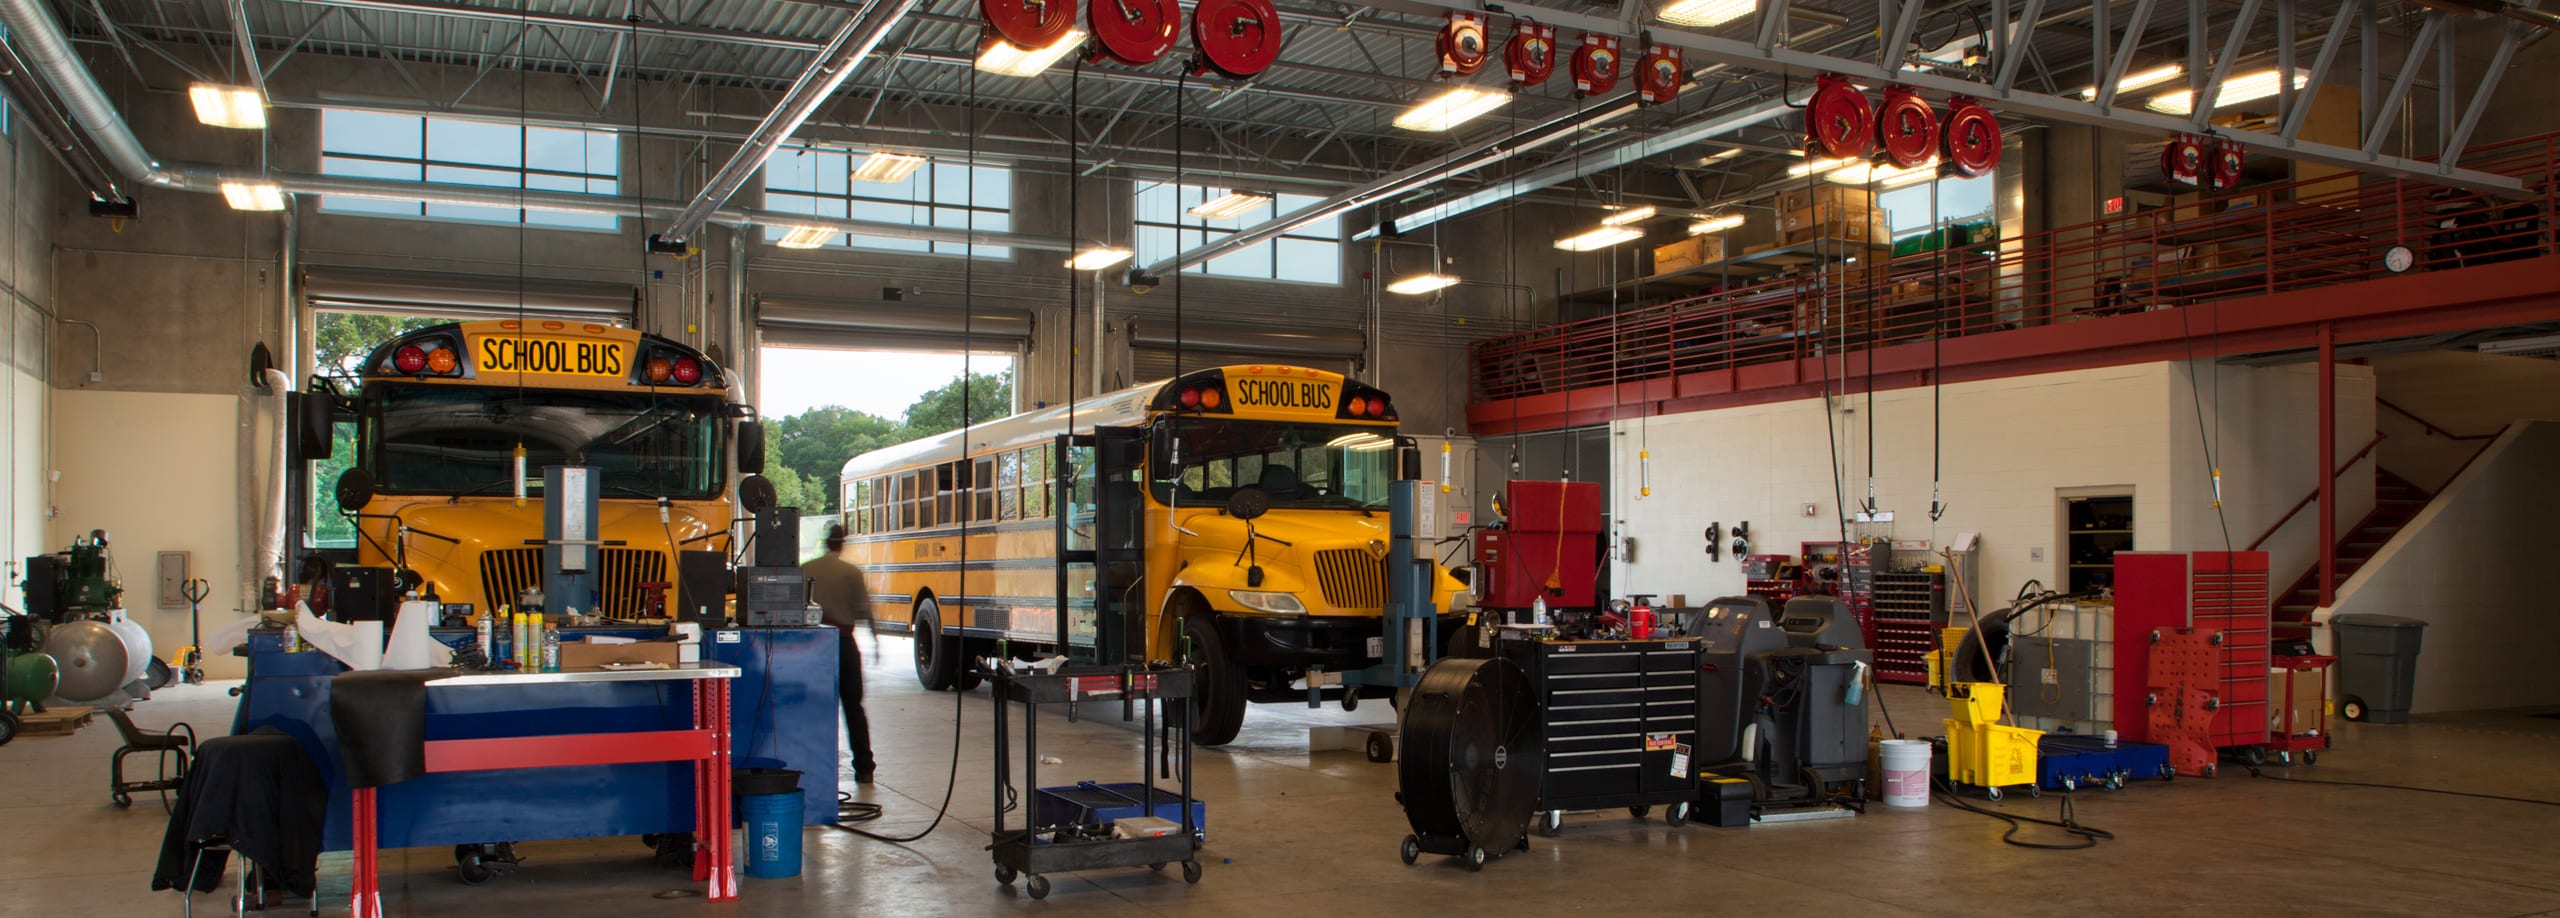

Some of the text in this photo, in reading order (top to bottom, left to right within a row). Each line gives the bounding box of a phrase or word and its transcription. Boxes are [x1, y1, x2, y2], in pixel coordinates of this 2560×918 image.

[482, 338, 621, 375] SCHOOL BUS
[1238, 379, 1331, 409] SCHOOL BUS
